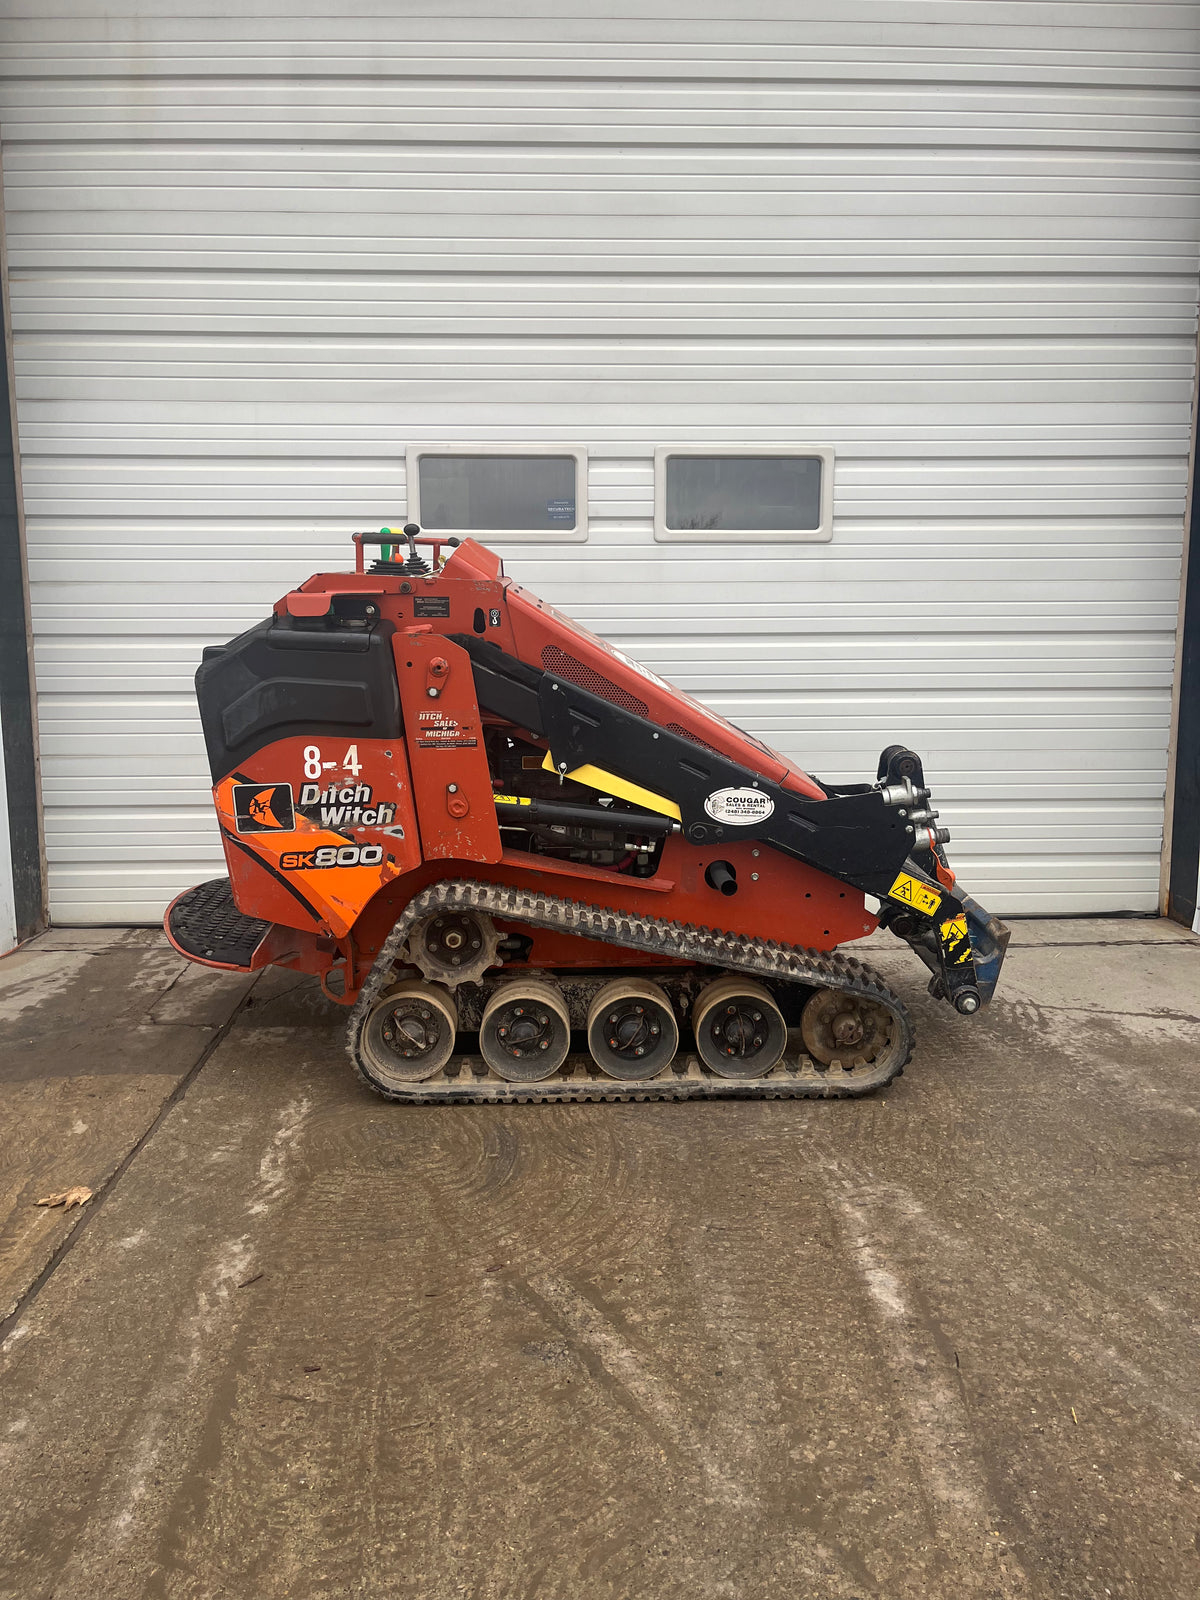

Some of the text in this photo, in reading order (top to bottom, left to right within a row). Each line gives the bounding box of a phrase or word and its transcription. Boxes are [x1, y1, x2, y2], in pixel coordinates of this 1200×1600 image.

[301, 782, 370, 805] Ditch
[320, 804, 394, 826] Witch
[282, 846, 383, 870] SK800
